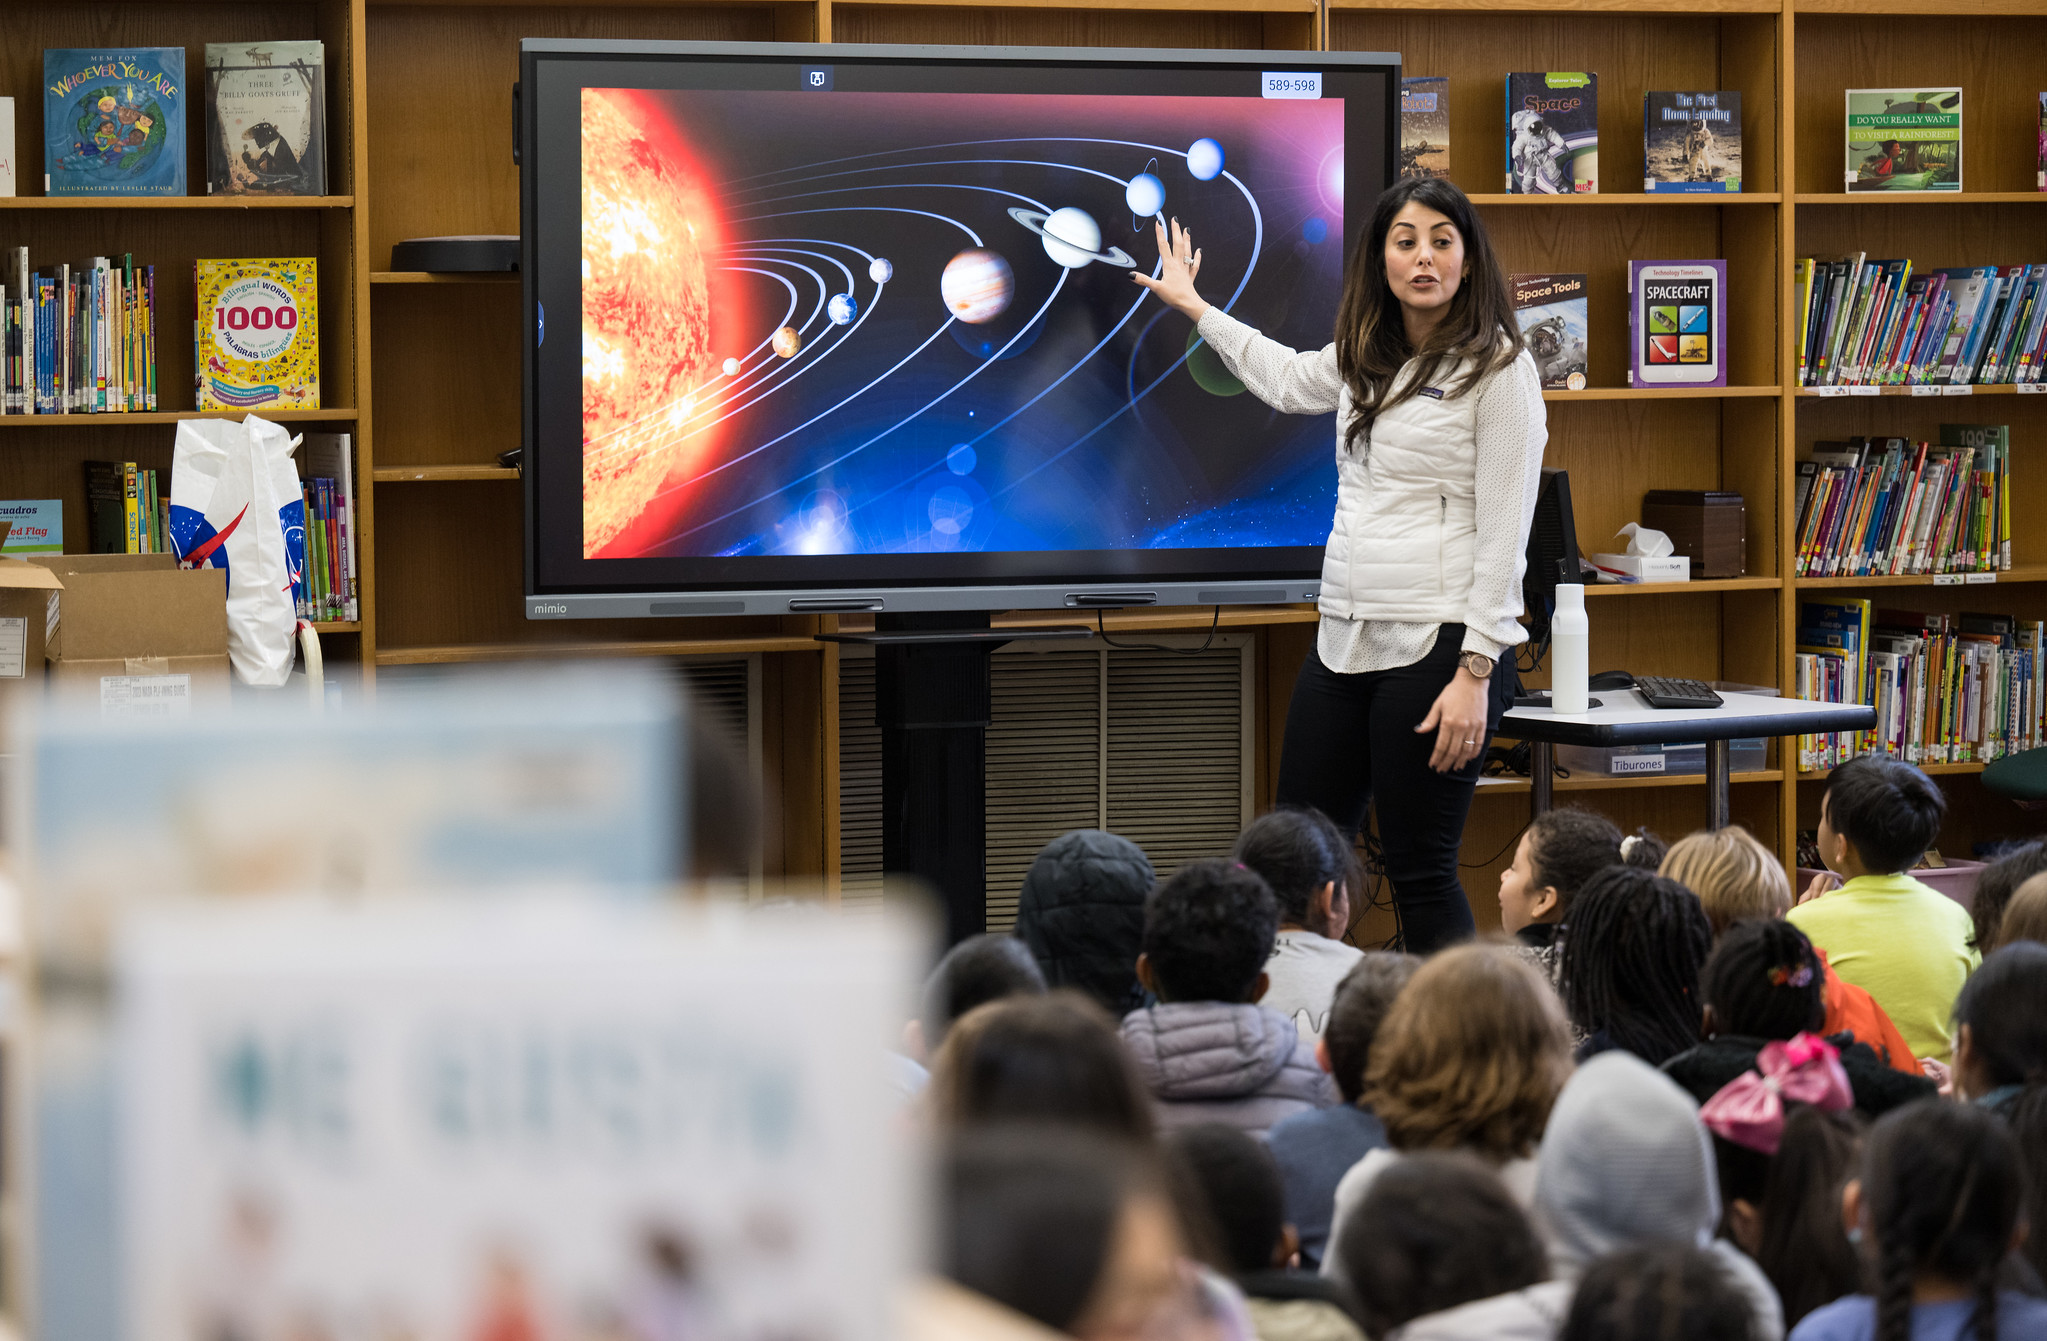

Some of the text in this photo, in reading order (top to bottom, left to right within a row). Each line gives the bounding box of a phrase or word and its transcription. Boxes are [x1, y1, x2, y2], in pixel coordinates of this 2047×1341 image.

[50, 62, 178, 100] WHOEVER YOU ARE
[1269, 80, 1315, 92] 589-598
[1402, 96, 1434, 110] Robots
[1524, 95, 1581, 114] Space
[1676, 93, 1718, 107] The First
[1662, 107, 1731, 124] Moon Landing
[222, 280, 292, 304] Bilingual WORDS
[1516, 280, 1581, 302] Space Tools
[1647, 286, 1709, 300] SPACECRAFT
[216, 306, 297, 330] 1000
[224, 331, 259, 359] PALABRAS
[25, 527, 48, 538] Flag
[535, 603, 567, 614] mimio
[1614, 760, 1662, 770] Tiburones
